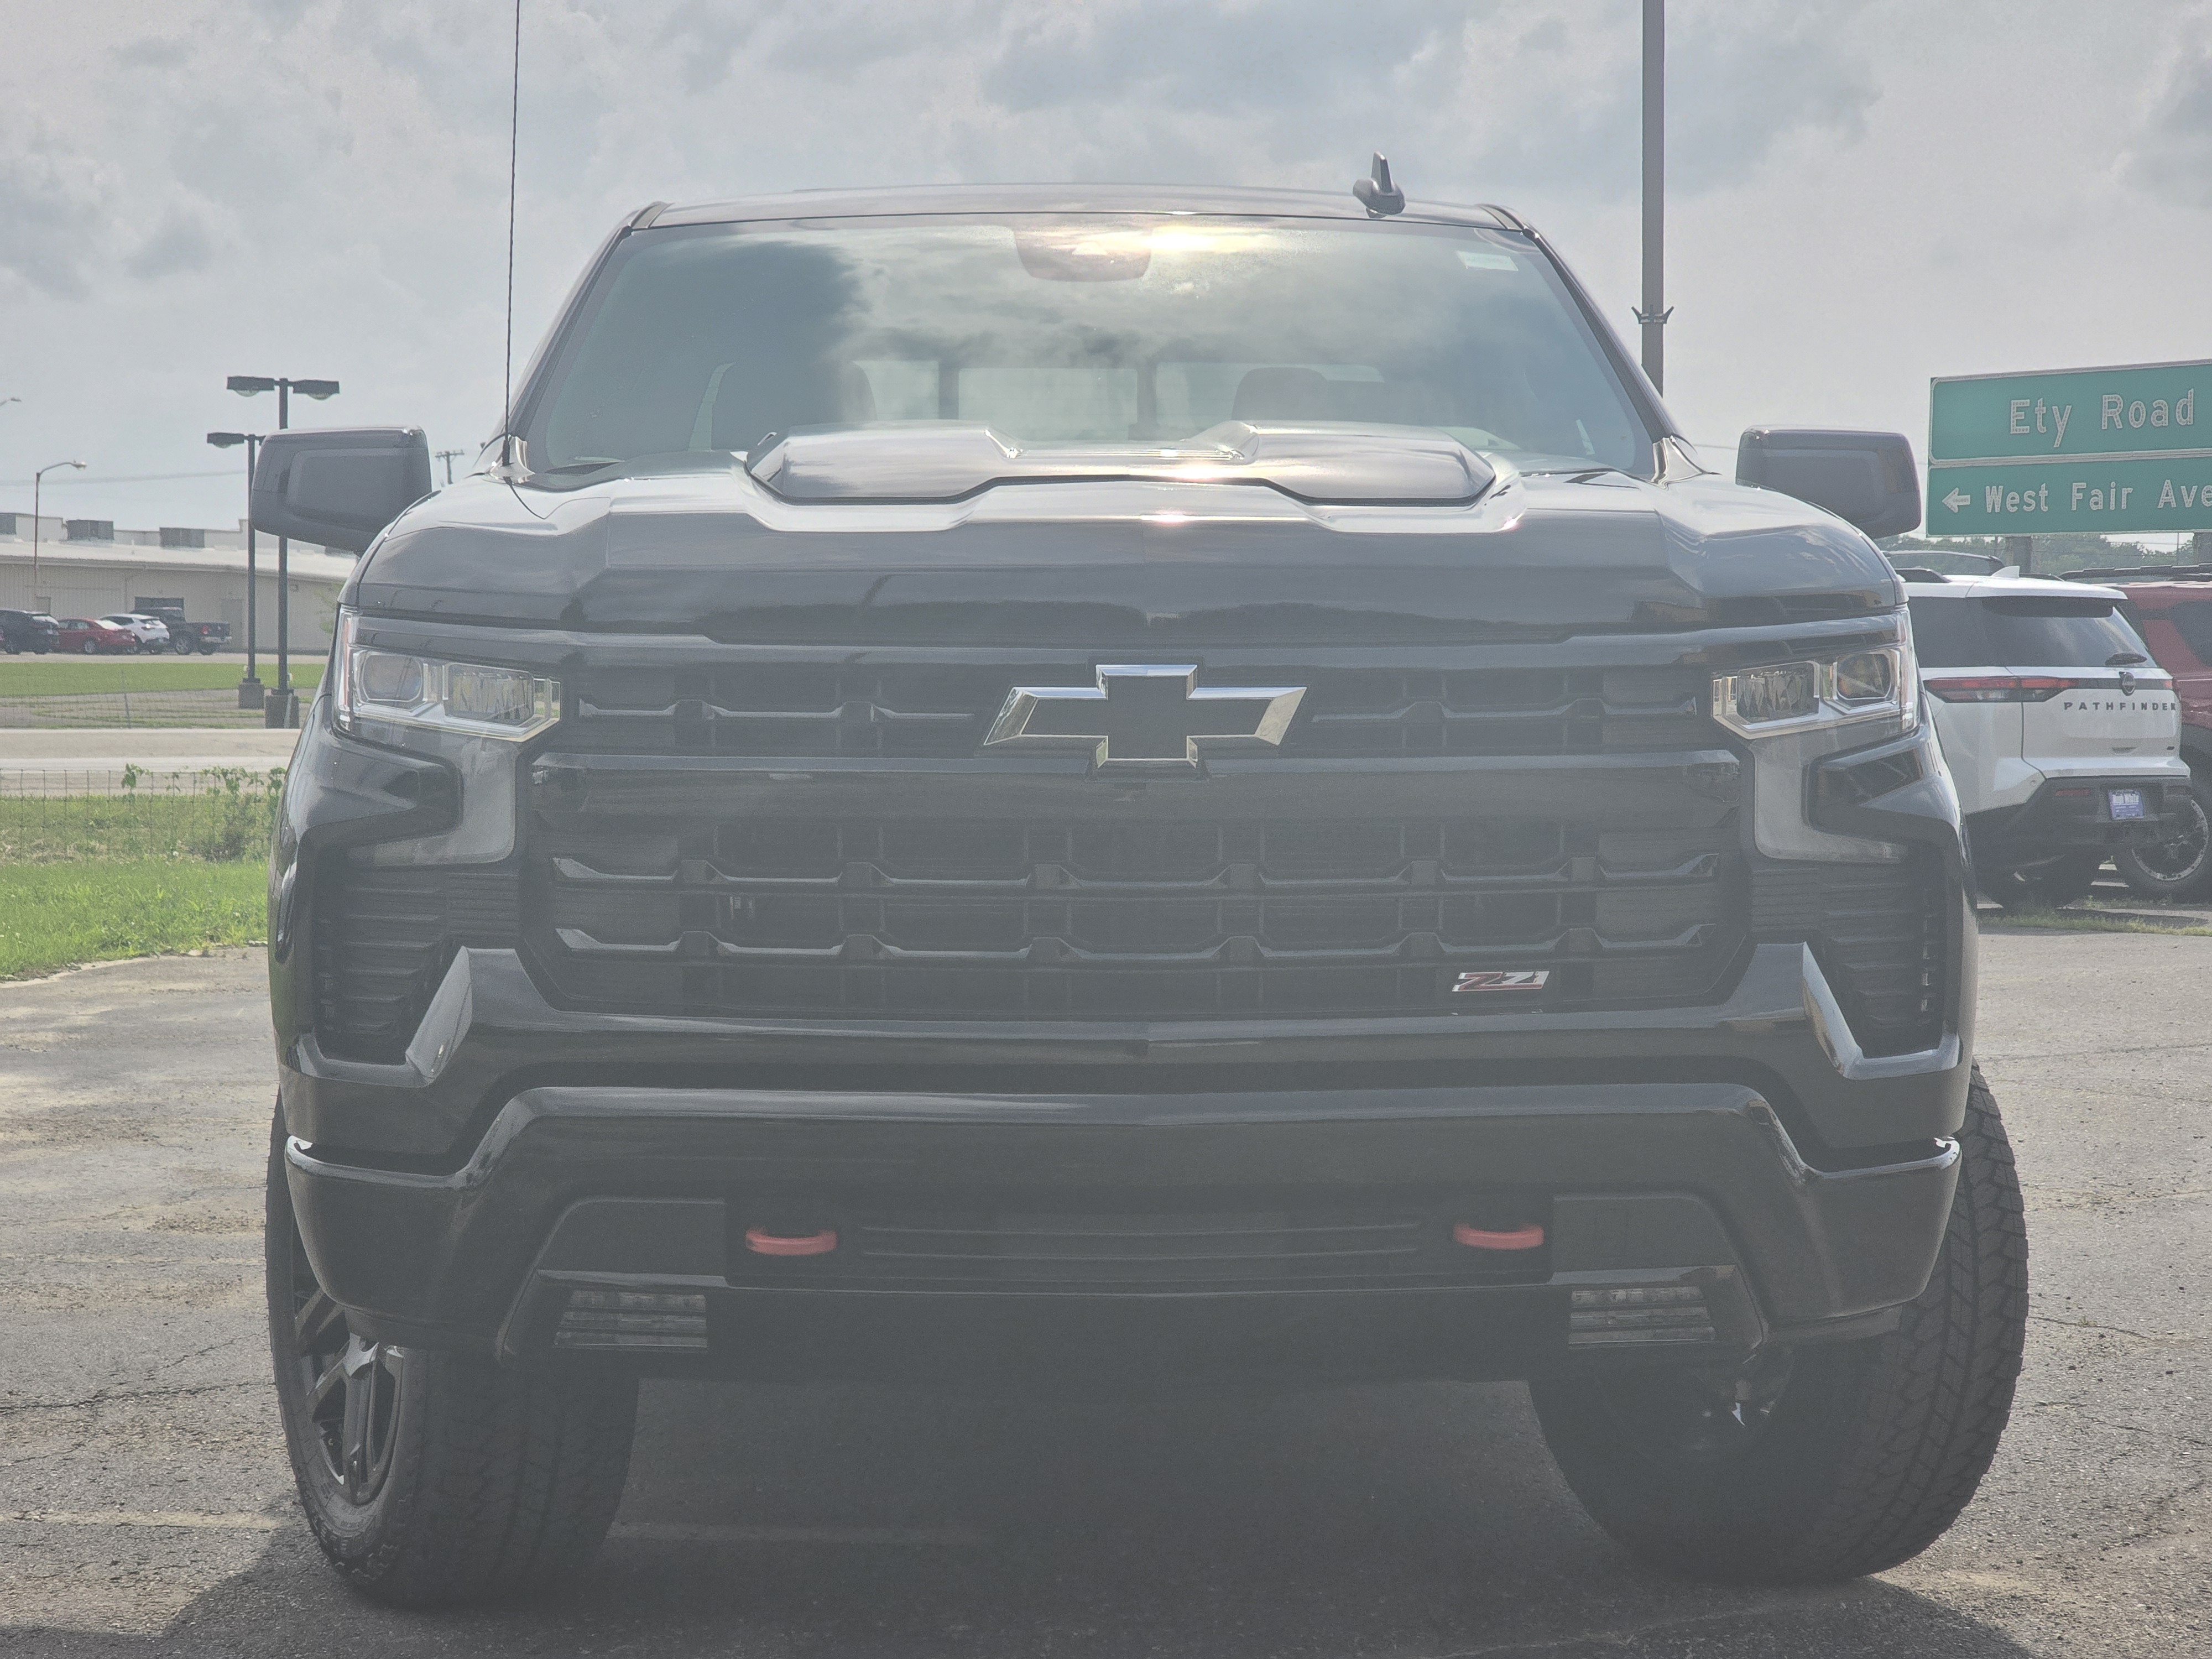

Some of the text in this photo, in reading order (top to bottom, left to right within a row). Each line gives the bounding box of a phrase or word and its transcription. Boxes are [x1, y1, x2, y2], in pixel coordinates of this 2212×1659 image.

[2010, 388, 2194, 447] Ety Road
[1985, 479, 2212, 513] West Fair Ave
[2064, 702, 2176, 711] PATHFINDER
[1452, 971, 1550, 992] Z71
